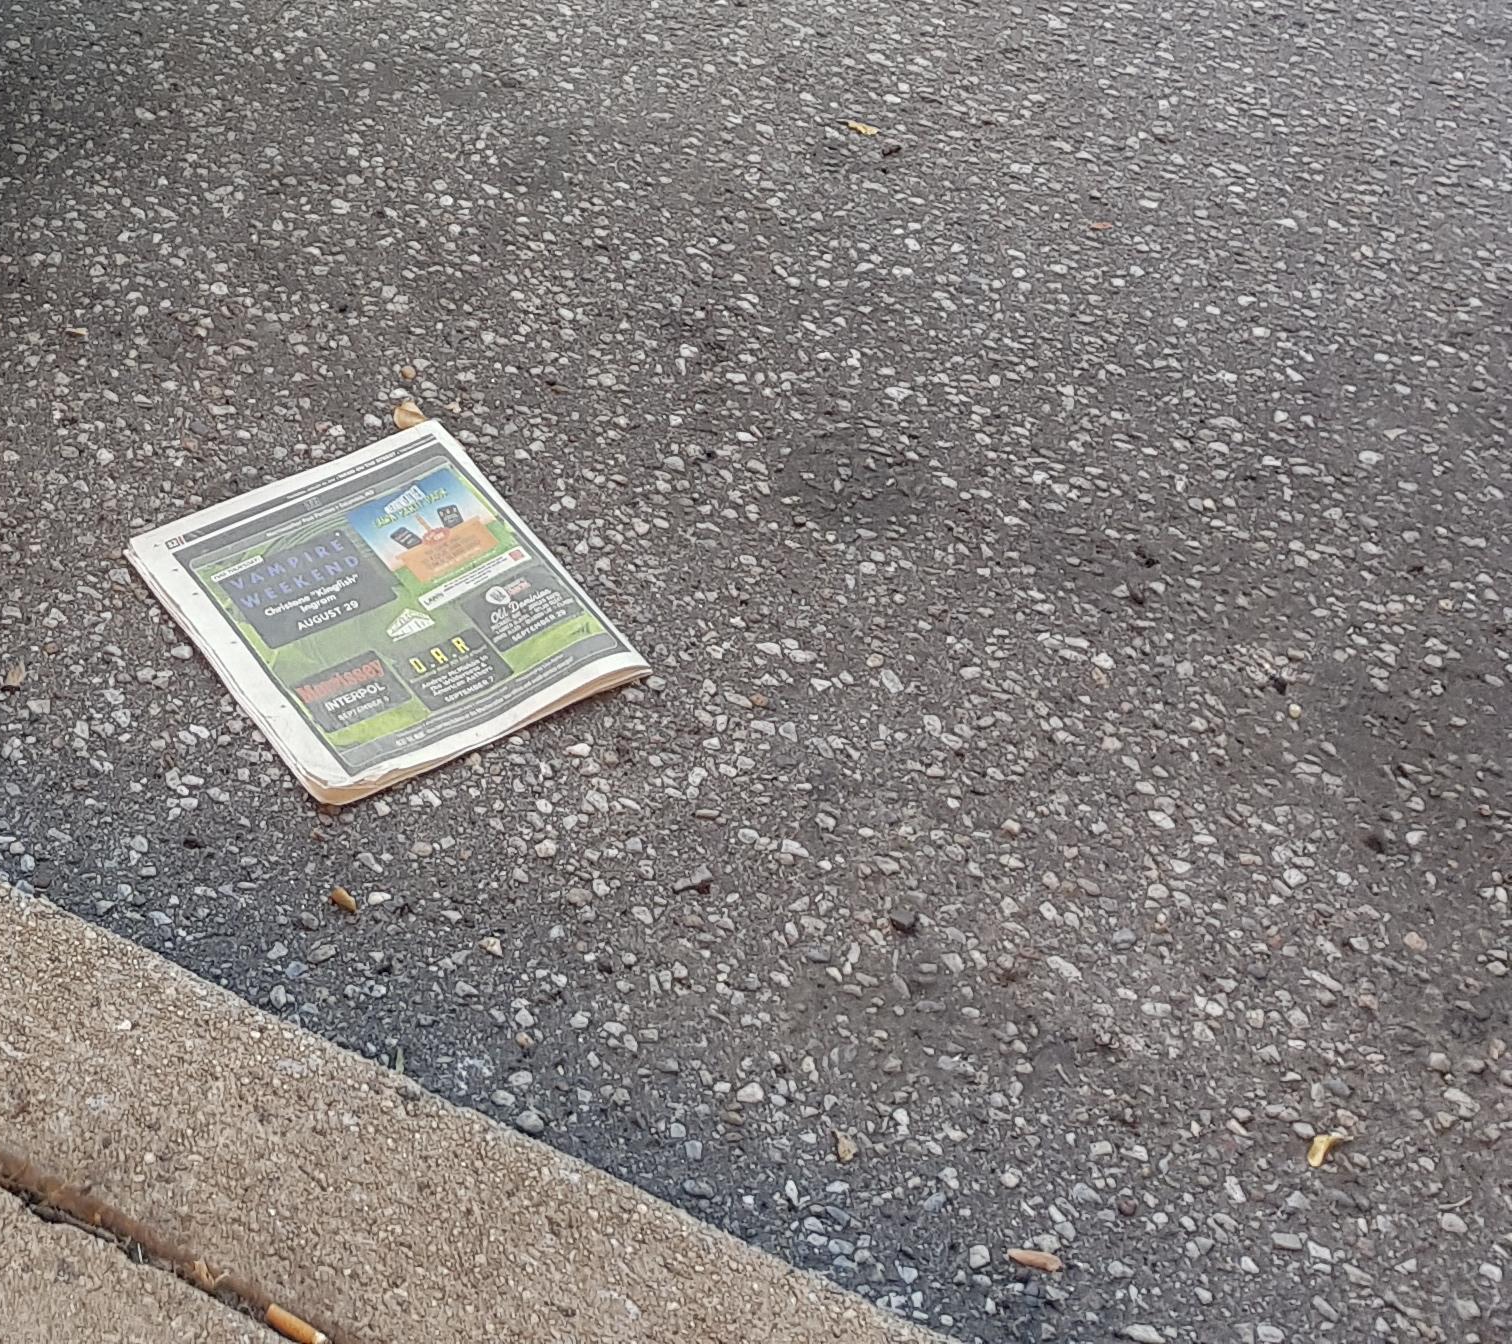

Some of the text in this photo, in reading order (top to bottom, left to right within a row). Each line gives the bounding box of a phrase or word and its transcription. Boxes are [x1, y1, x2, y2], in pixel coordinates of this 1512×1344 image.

[229, 539, 345, 589] VAMPIRE
[239, 555, 359, 608] WEEKEND
[297, 600, 359, 631] AUGUST 29
[324, 682, 386, 712] INTERPOL
